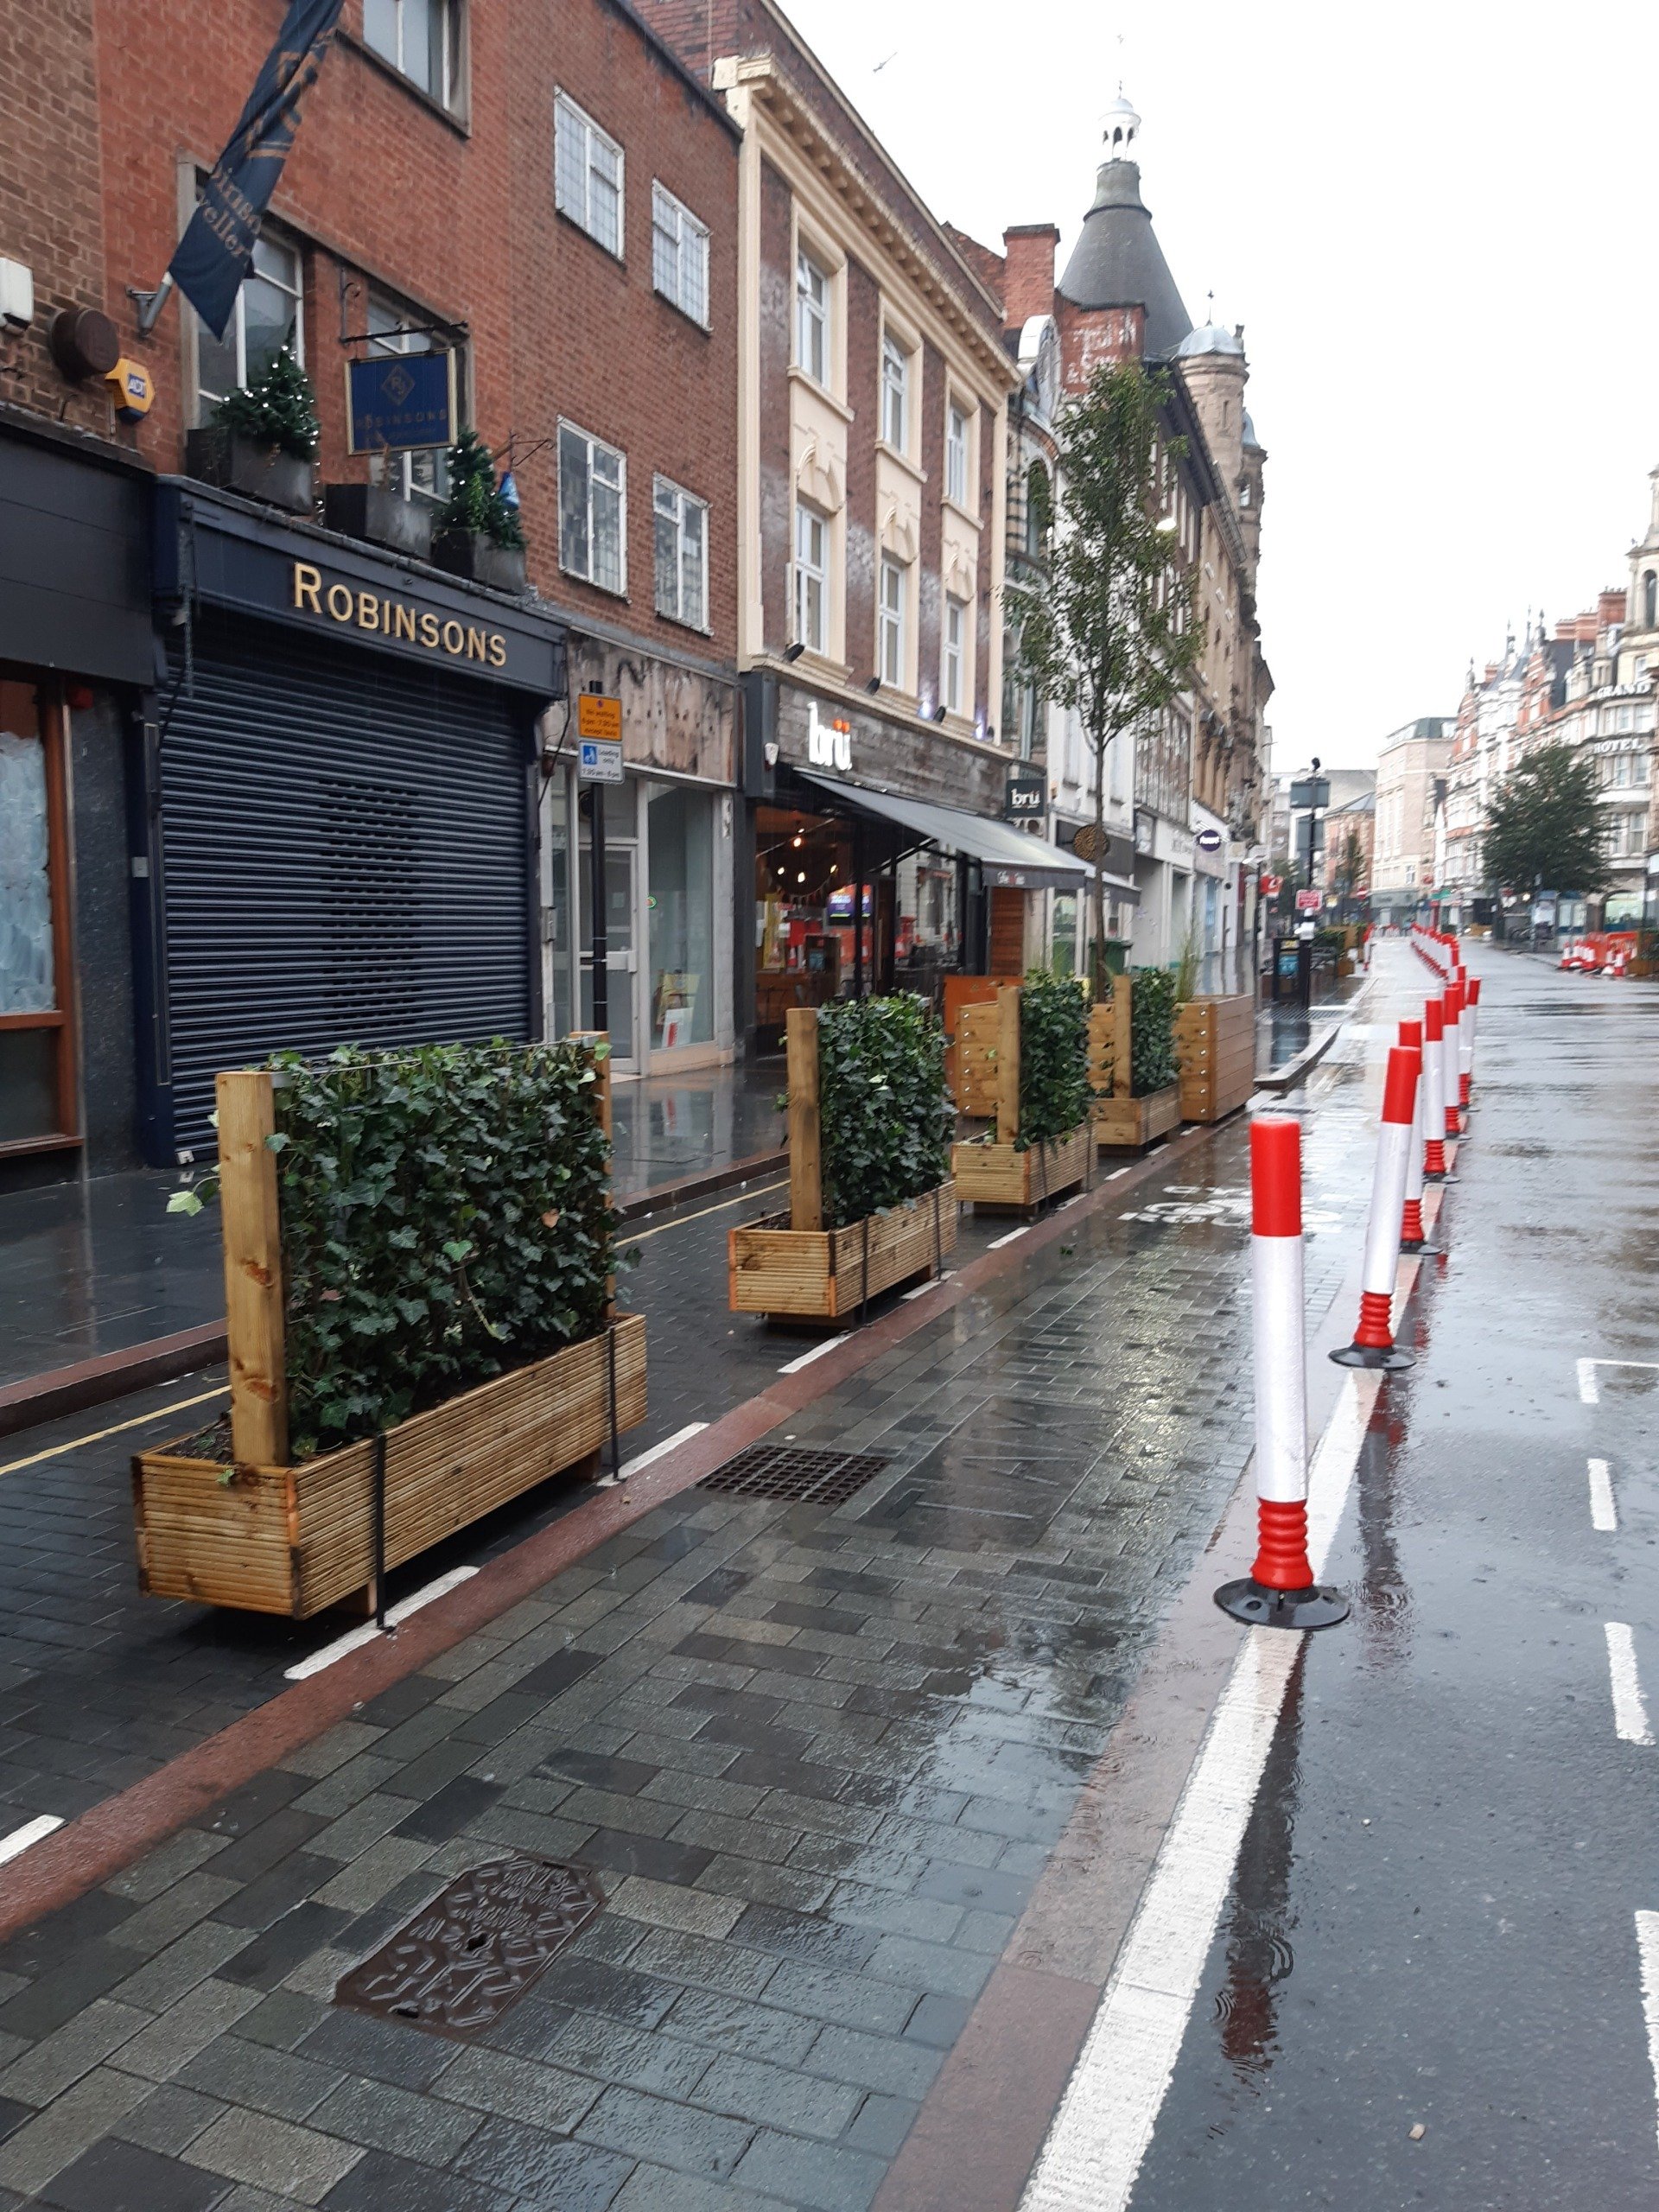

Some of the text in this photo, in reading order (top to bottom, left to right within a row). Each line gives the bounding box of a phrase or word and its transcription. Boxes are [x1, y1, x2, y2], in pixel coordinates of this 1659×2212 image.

[806, 701, 853, 771] brü
[1593, 738, 1644, 753] HOTEL
[1010, 787, 1041, 805] brü
